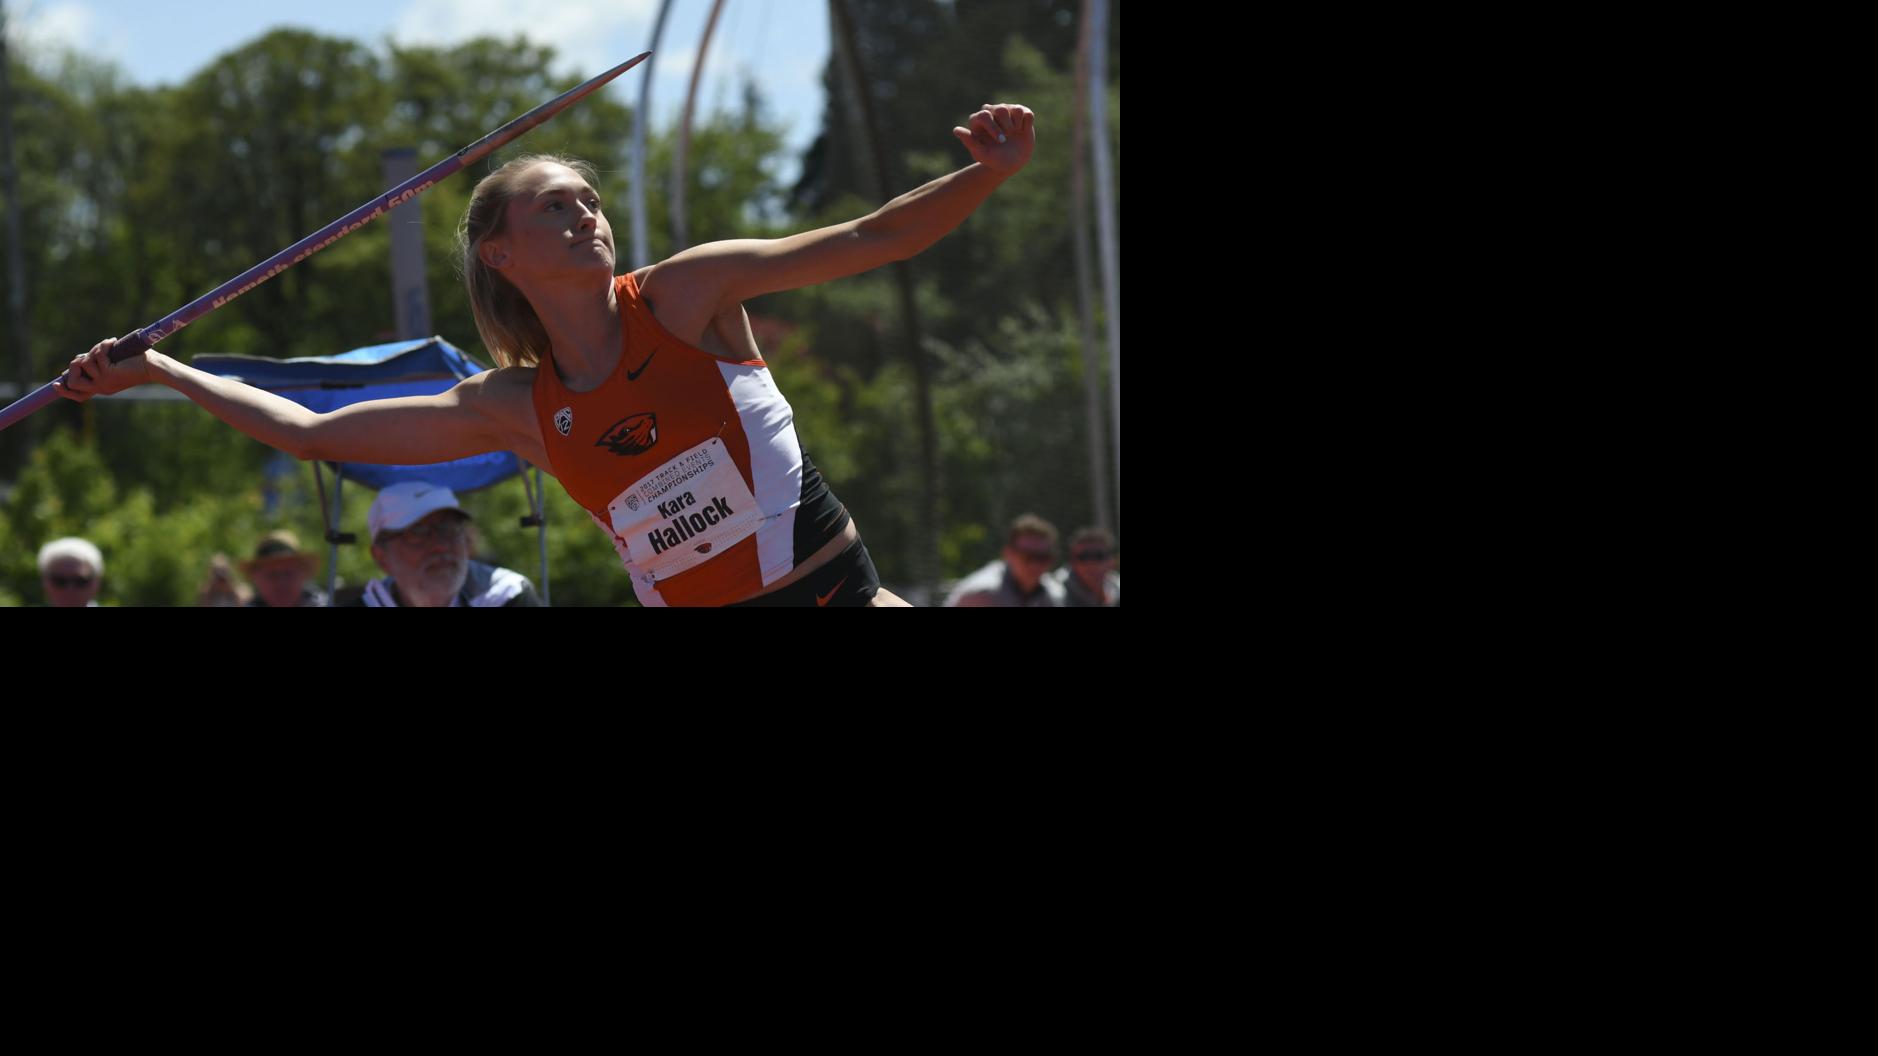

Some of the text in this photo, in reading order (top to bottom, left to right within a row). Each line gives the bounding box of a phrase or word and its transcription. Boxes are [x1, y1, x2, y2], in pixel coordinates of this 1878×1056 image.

[640, 479, 655, 493] 2017
[656, 464, 678, 481] TRACK
[686, 448, 708, 463] FIELD
[642, 453, 712, 497] COMBINED EVENTS
[648, 459, 715, 503] CHAMPIONSHIPS
[647, 496, 734, 555] Hallock
[657, 491, 696, 520] Kara
